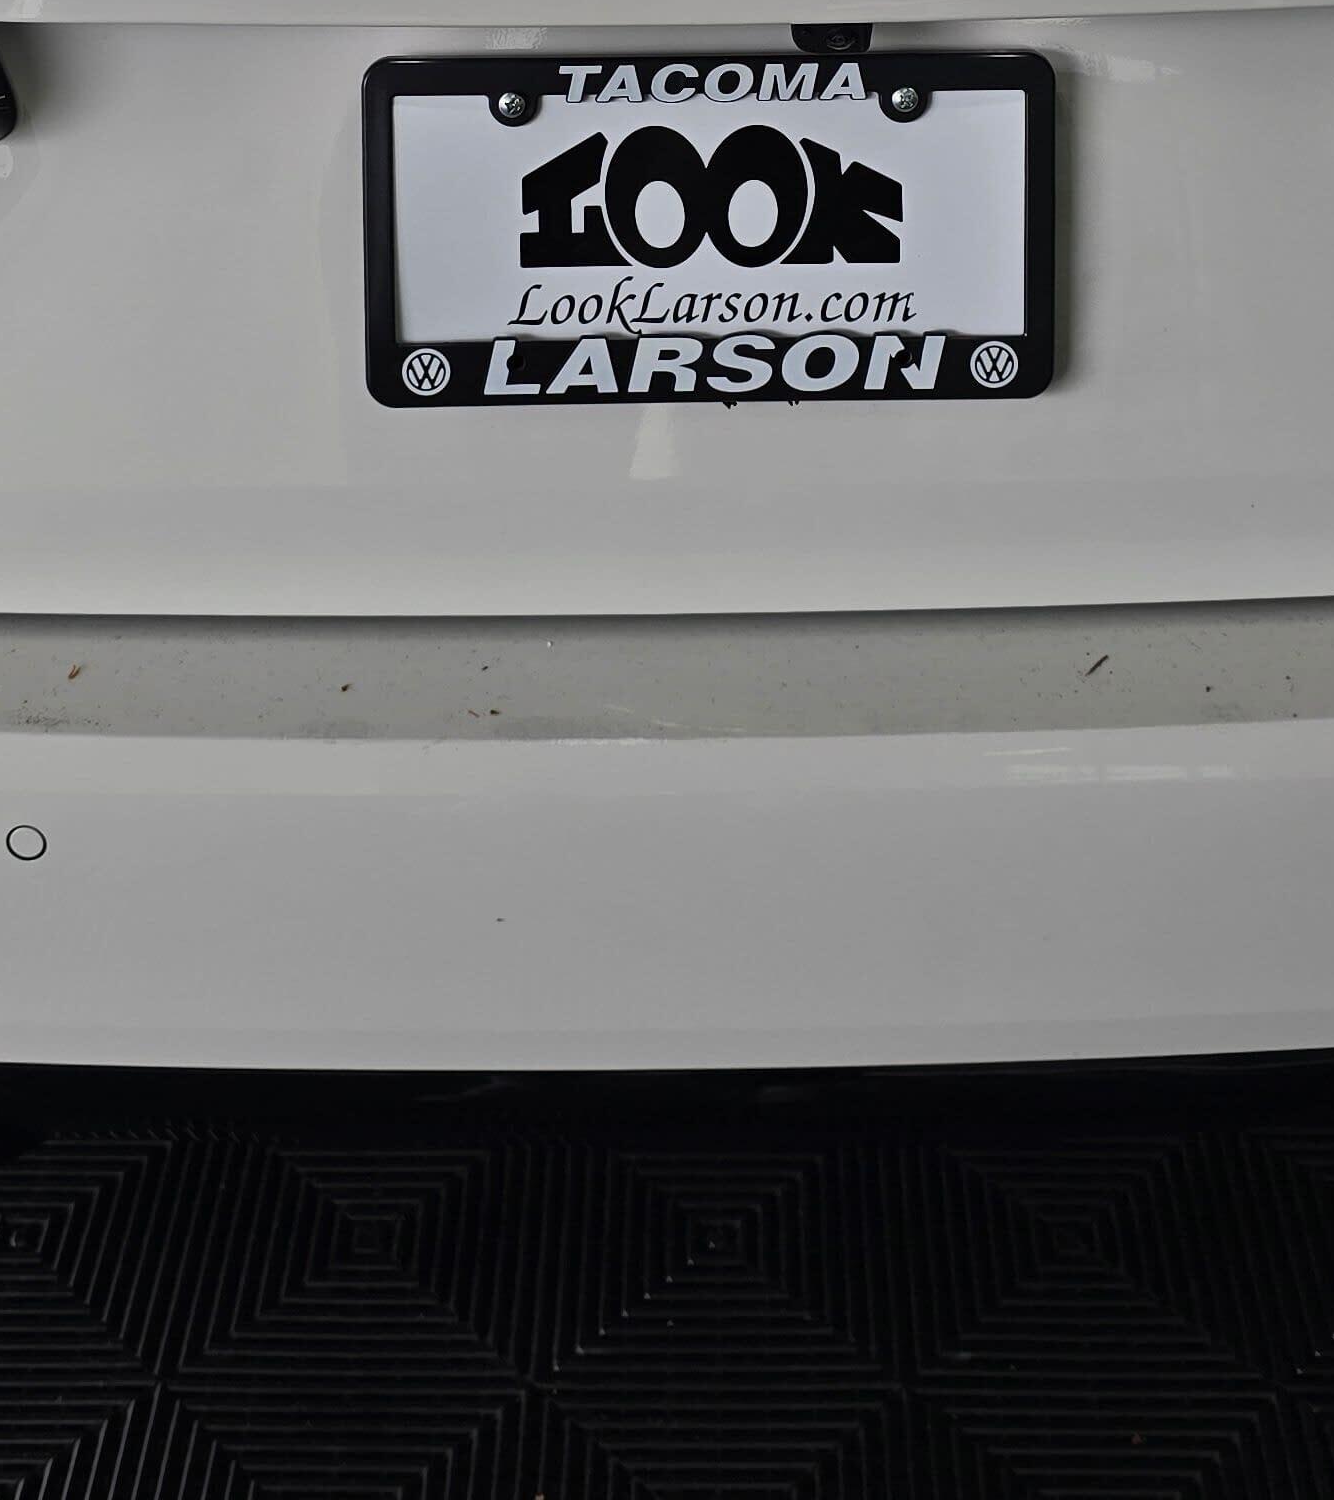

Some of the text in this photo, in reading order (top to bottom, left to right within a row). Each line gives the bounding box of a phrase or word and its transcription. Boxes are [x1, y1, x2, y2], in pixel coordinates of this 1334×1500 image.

[558, 62, 867, 103] TACOMA
[520, 125, 903, 269] LOOK
[507, 276, 917, 333] LookLarson.com
[483, 334, 946, 396] LARSON
